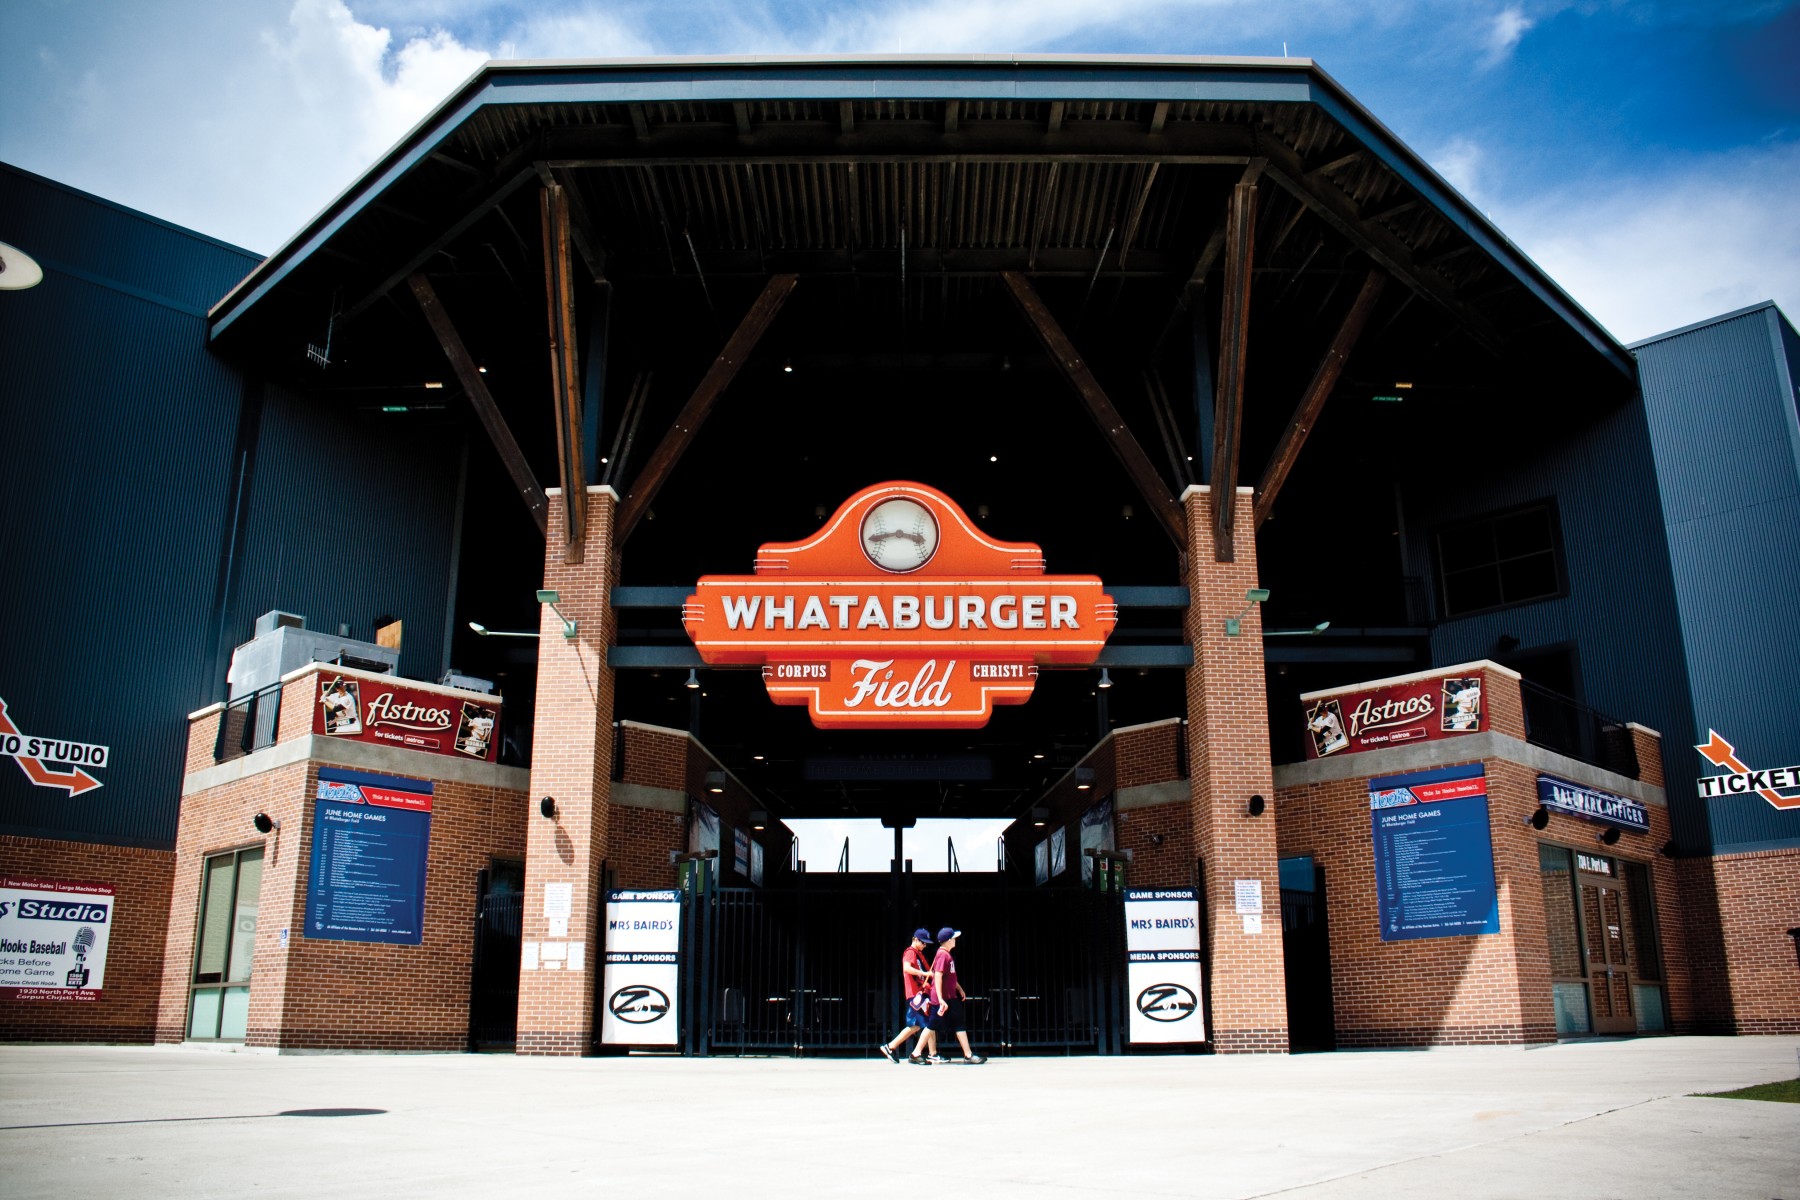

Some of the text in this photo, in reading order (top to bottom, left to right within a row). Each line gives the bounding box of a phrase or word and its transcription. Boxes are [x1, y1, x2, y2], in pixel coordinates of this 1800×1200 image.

[720, 594, 1080, 630] WHATABURGER
[776, 664, 828, 679] CORPUS
[972, 664, 1025, 679] CHRISTI
[843, 658, 957, 708] Field
[366, 693, 452, 731] Astros
[1349, 694, 1435, 737] Astros
[374, 730, 404, 742] for tickets
[1360, 735, 1389, 745] for tickets
[27, 738, 105, 764] STUDIO
[1552, 785, 1644, 824] BALLPARK OFFICES
[325, 809, 387, 822] JUNE HOME GAMES
[1381, 810, 1441, 824] JUNE HOME GAMES
[611, 891, 675, 900] GAME SPONSOR
[1129, 891, 1193, 899] GAME SPONSOR
[20, 901, 105, 921] Studio
[609, 919, 673, 931] MRS BAIRD'S
[1131, 917, 1195, 929] MRS BAIRD'S
[0, 938, 67, 955] Hooks Baseball
[606, 954, 676, 962] MEDIA SPONSORS
[1157, 952, 1200, 960] SPONSORS
[18, 959, 51, 967] Before
[24, 968, 55, 976] Game
